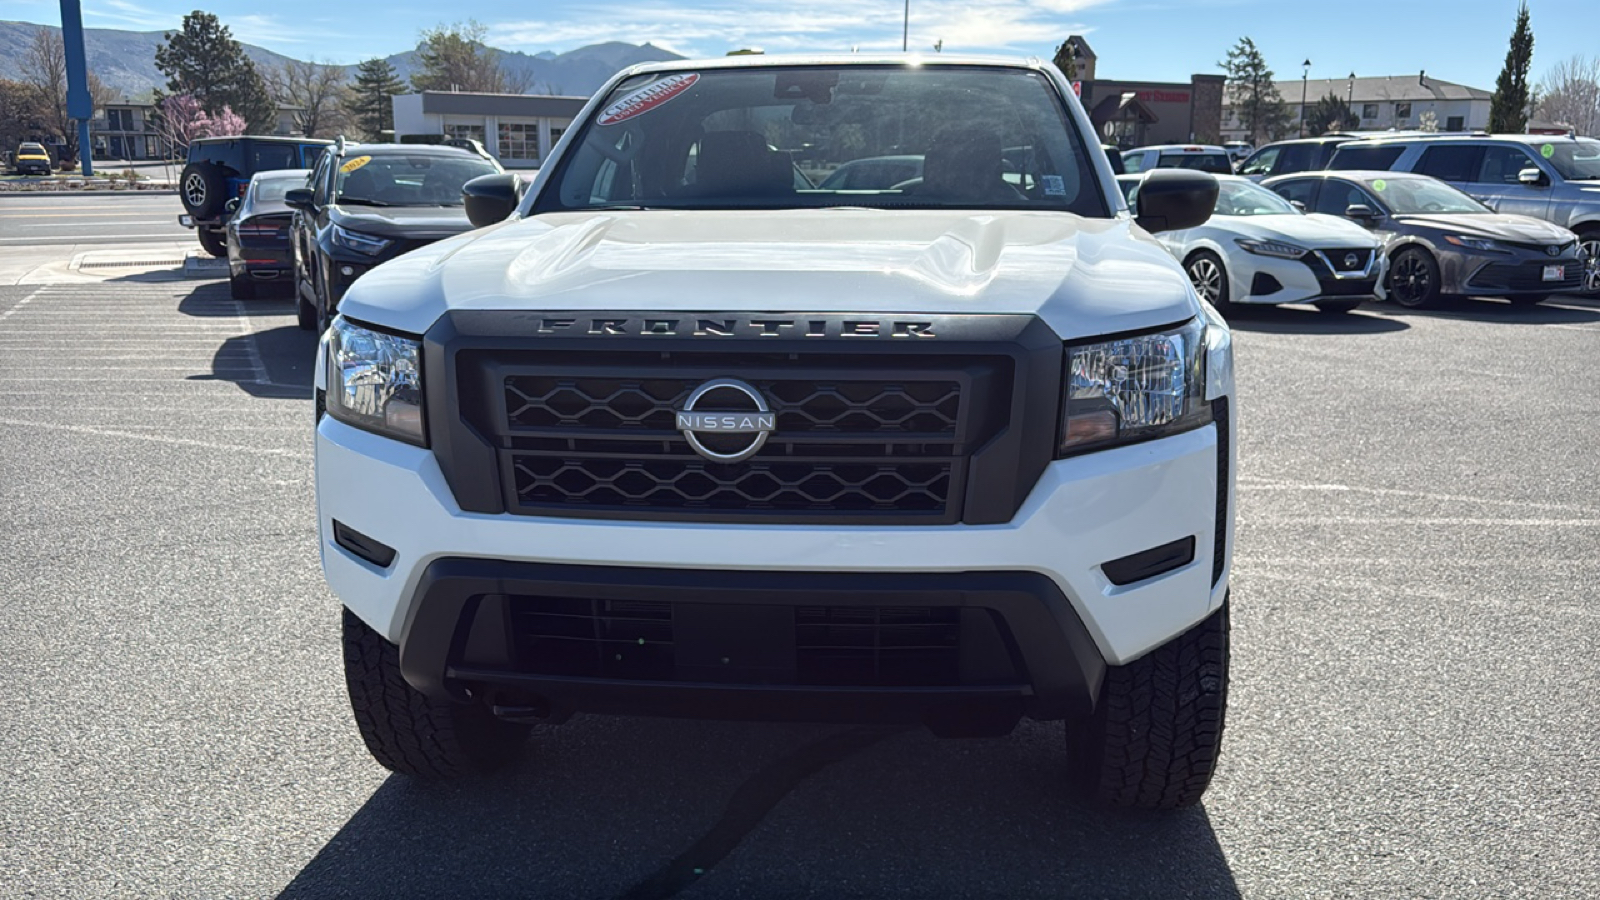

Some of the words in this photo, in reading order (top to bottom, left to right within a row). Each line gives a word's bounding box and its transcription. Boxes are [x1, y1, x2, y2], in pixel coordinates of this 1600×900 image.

[605, 74, 684, 116] CERTIFIED
[614, 102, 645, 120] USED
[645, 78, 693, 103] VEHICLE
[537, 318, 936, 337] FRONTIER
[677, 414, 775, 429] NISSAN
